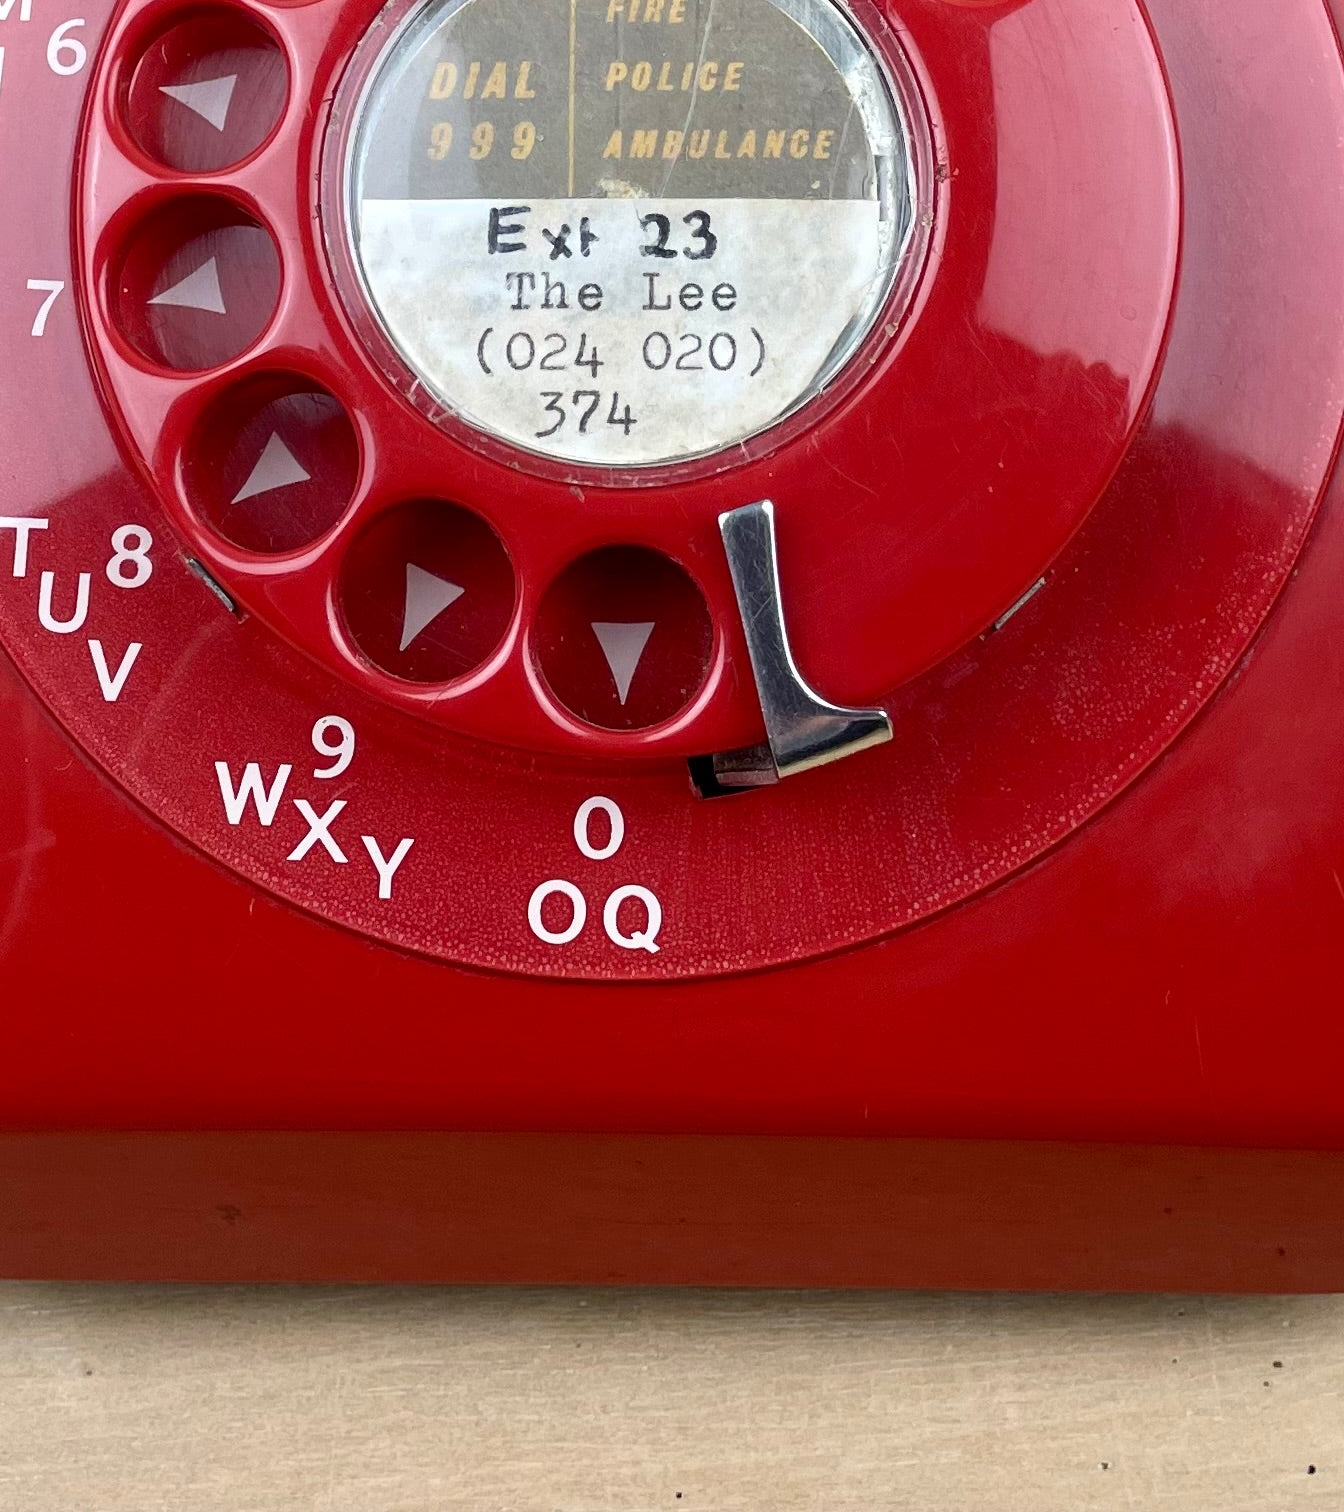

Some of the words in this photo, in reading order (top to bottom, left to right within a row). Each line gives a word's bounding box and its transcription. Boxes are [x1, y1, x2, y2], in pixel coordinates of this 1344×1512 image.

[45, 18, 88, 77] 6
[429, 60, 537, 101] DIAL
[605, 61, 745, 93] POLICE
[602, 128, 837, 161] AMBULANCE
[638, 209, 718, 261] 23
[25, 278, 65, 338] 7
[505, 271, 605, 312] The
[641, 271, 739, 312] Lee
[475, 327, 606, 378] (024
[641, 327, 767, 377] 020)
[535, 390, 639, 439] 374
[105, 523, 154, 588] 8
[310, 714, 355, 779] 9
[572, 795, 625, 860] 0
[527, 878, 662, 954] OQ
